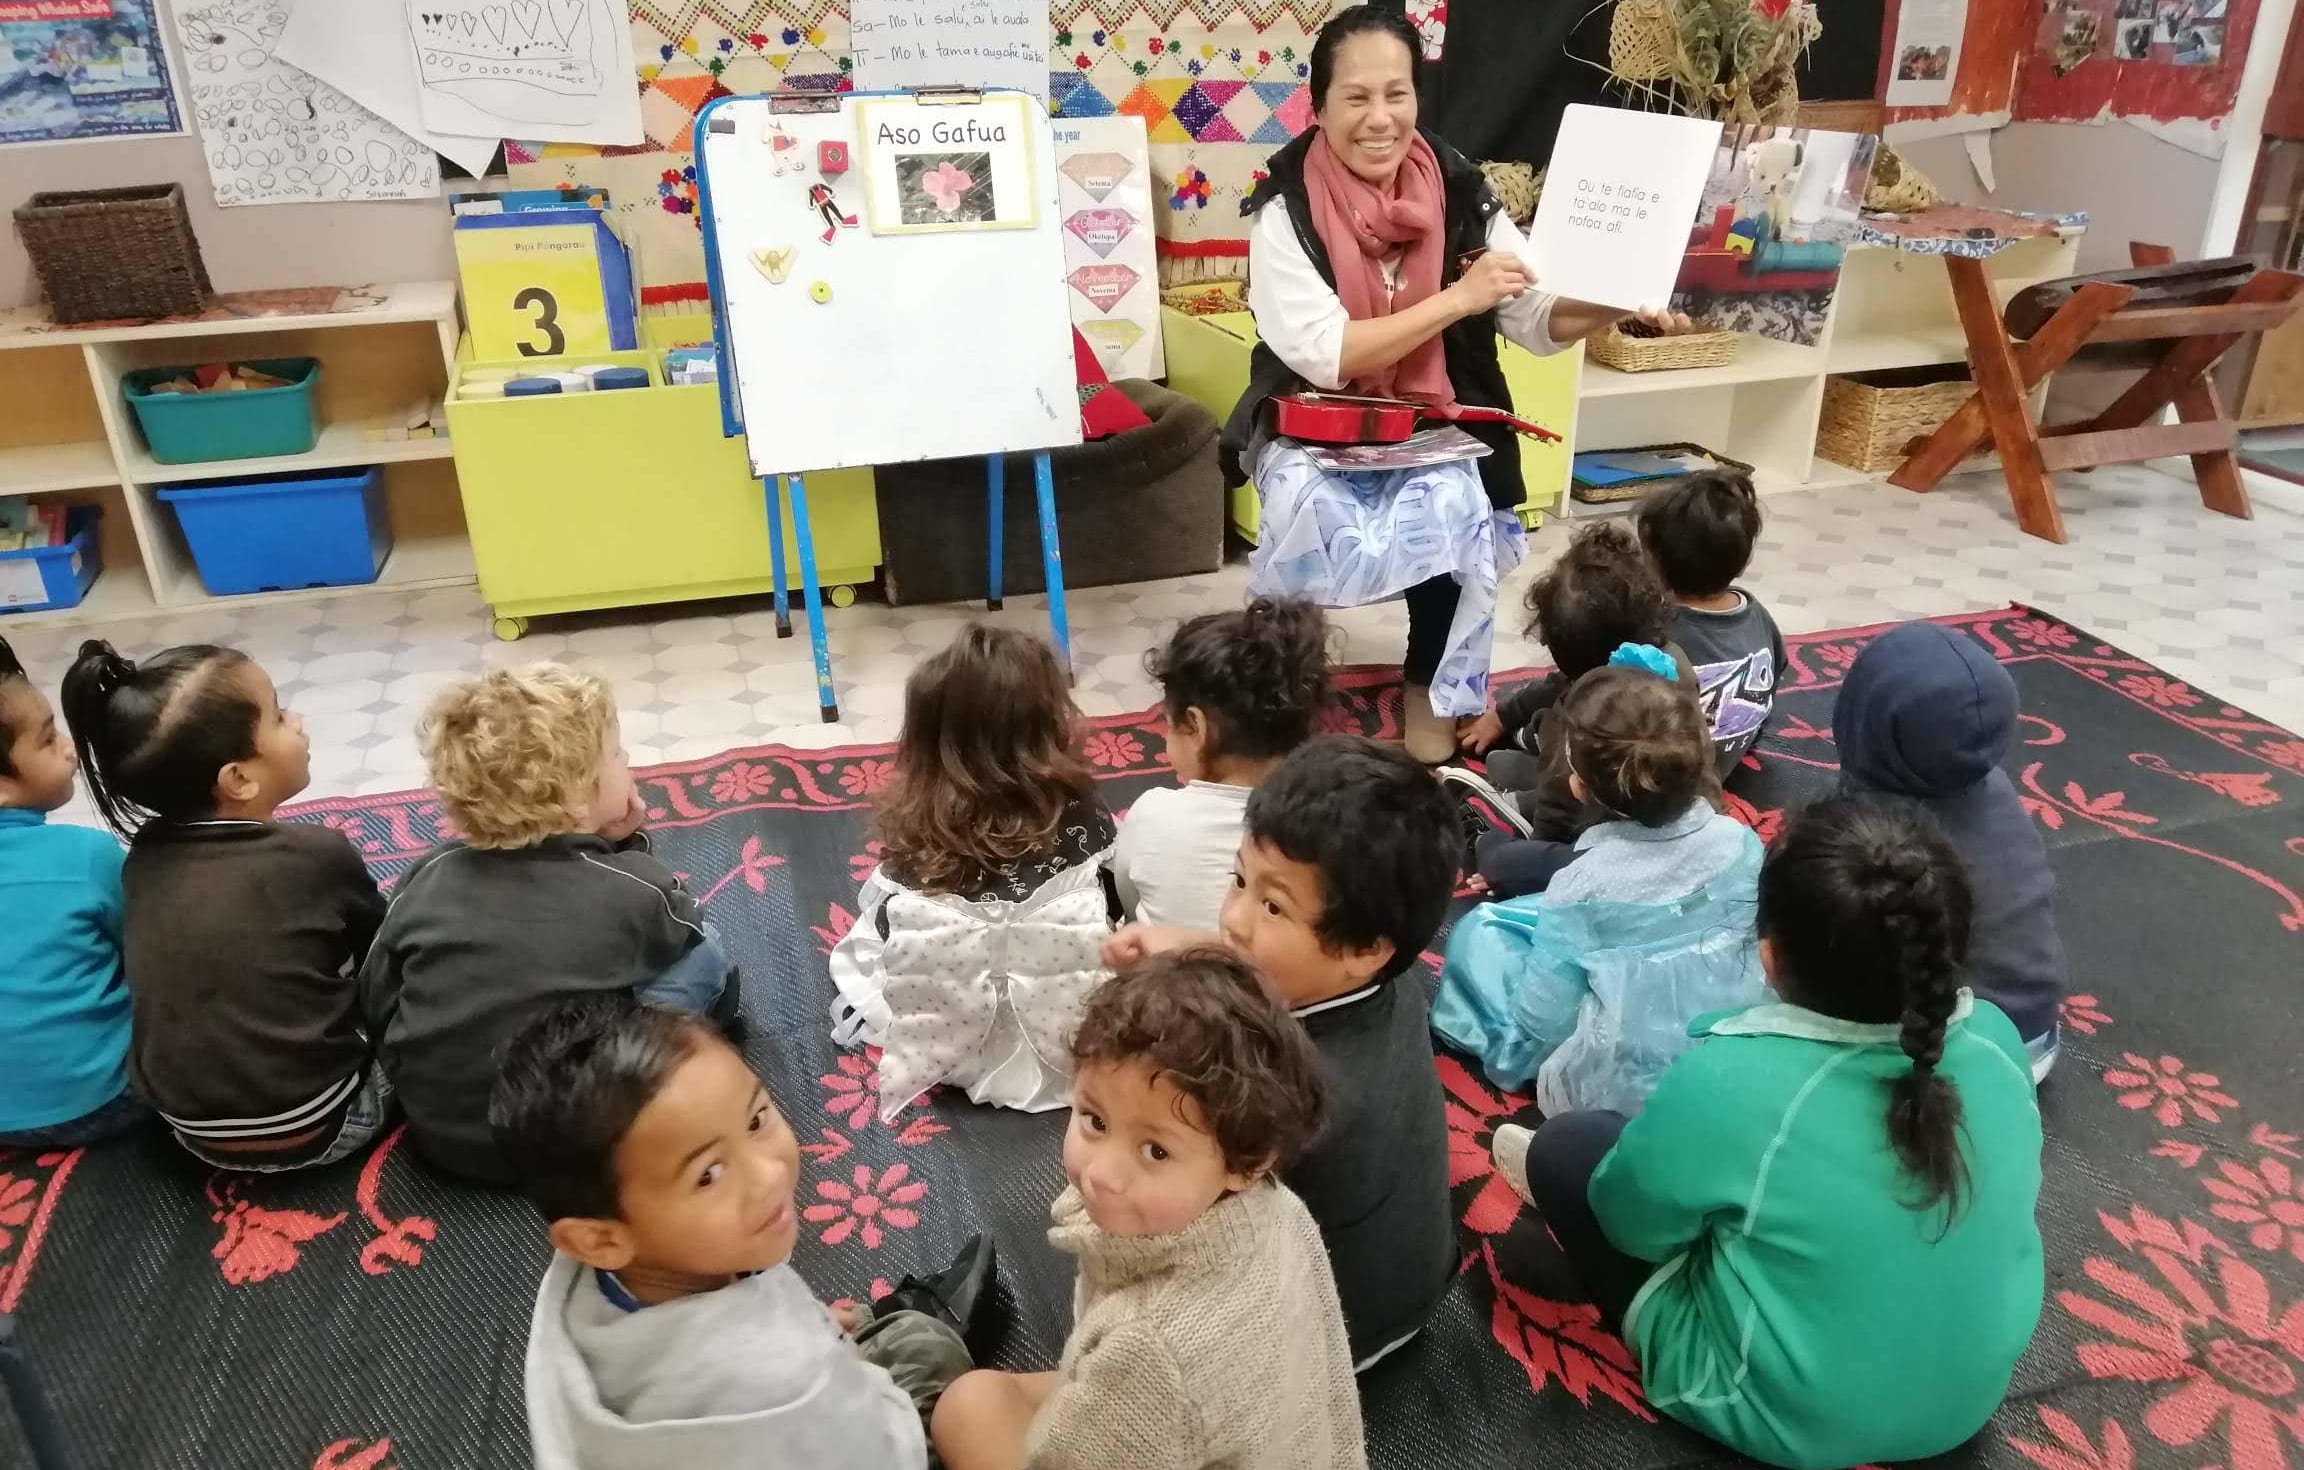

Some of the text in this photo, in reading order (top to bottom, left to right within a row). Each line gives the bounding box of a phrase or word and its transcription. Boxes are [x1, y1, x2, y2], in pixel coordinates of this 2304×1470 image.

[888, 14, 908, 29] Mo
[891, 45, 911, 61] Mo
[878, 119, 1007, 145] Aso Gafua
[1053, 128, 1081, 145] he year
[1578, 179, 1596, 193] Ou
[1601, 183, 1613, 196] te
[1651, 193, 1660, 203] e
[1612, 204, 1631, 217] ma
[1635, 206, 1647, 220] le
[513, 287, 566, 358] 3
